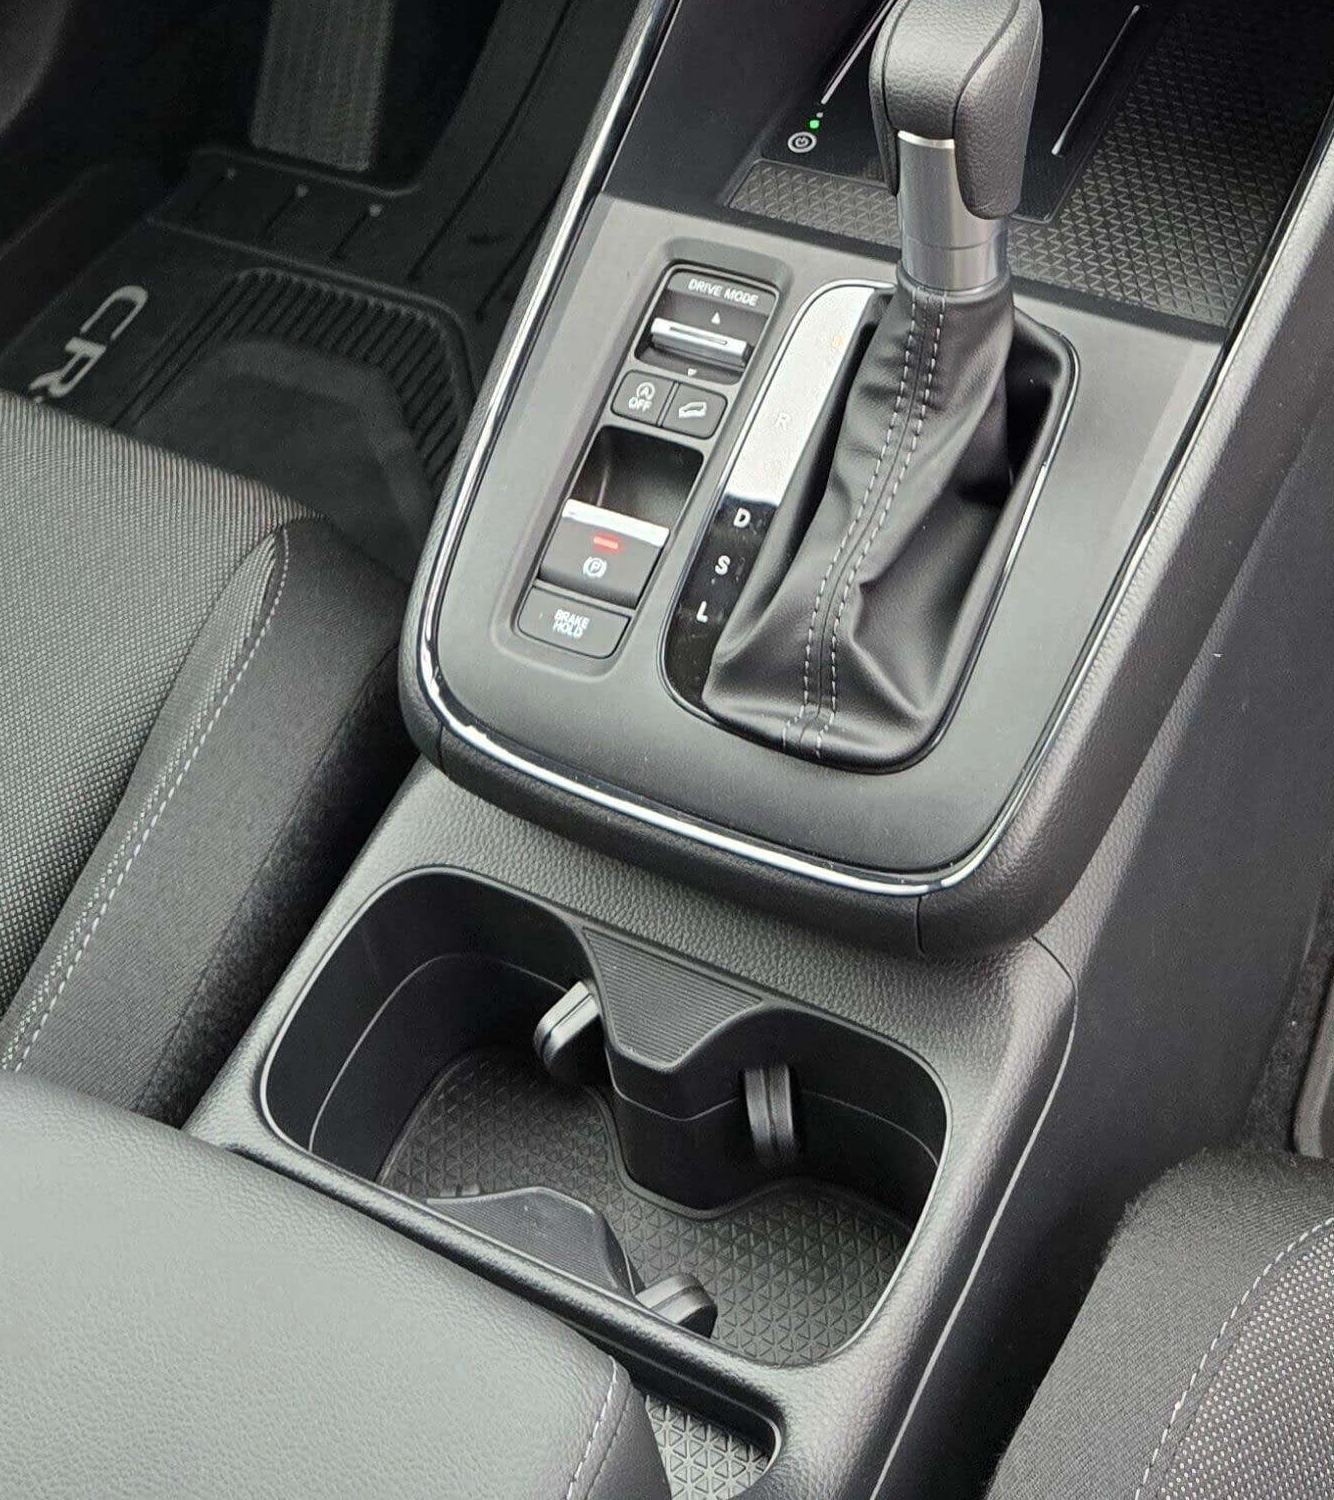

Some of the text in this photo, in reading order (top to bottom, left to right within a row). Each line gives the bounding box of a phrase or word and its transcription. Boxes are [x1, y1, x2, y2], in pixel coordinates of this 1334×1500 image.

[687, 278, 759, 306] DRIVE MODE
[628, 397, 653, 413] OFF
[733, 507, 752, 529] D
[714, 554, 731, 576] S
[554, 608, 590, 629] BRAKE
[695, 601, 708, 622] L
[553, 619, 583, 639] HOLD
